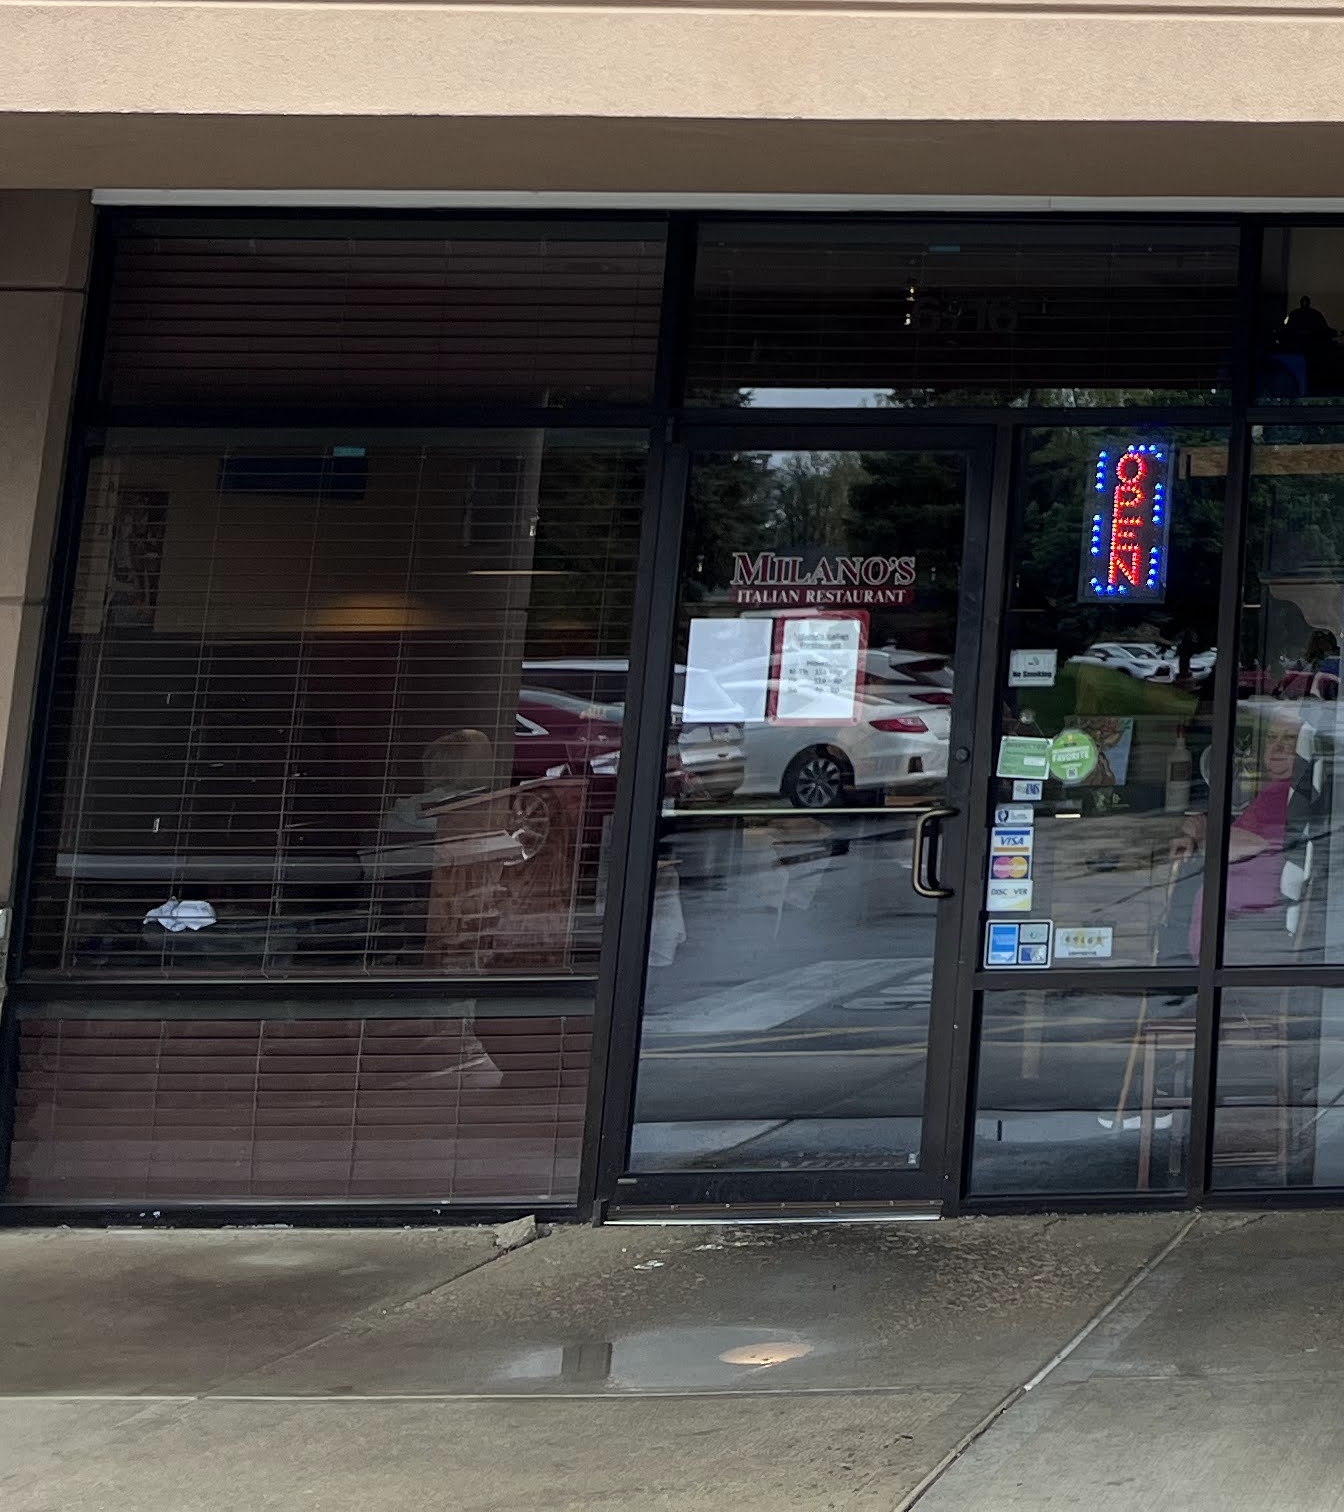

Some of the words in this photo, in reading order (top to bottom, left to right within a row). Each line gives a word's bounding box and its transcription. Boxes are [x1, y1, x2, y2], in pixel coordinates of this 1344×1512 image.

[1108, 452, 1147, 585] OPEN
[730, 552, 916, 586] MILANO'S
[737, 590, 800, 603] ITALIAN
[805, 589, 906, 603] RESTAURANT
[1022, 671, 1052, 679] Smoking
[1000, 837, 1025, 846] VISA
[990, 888, 1028, 896] DISCVER
